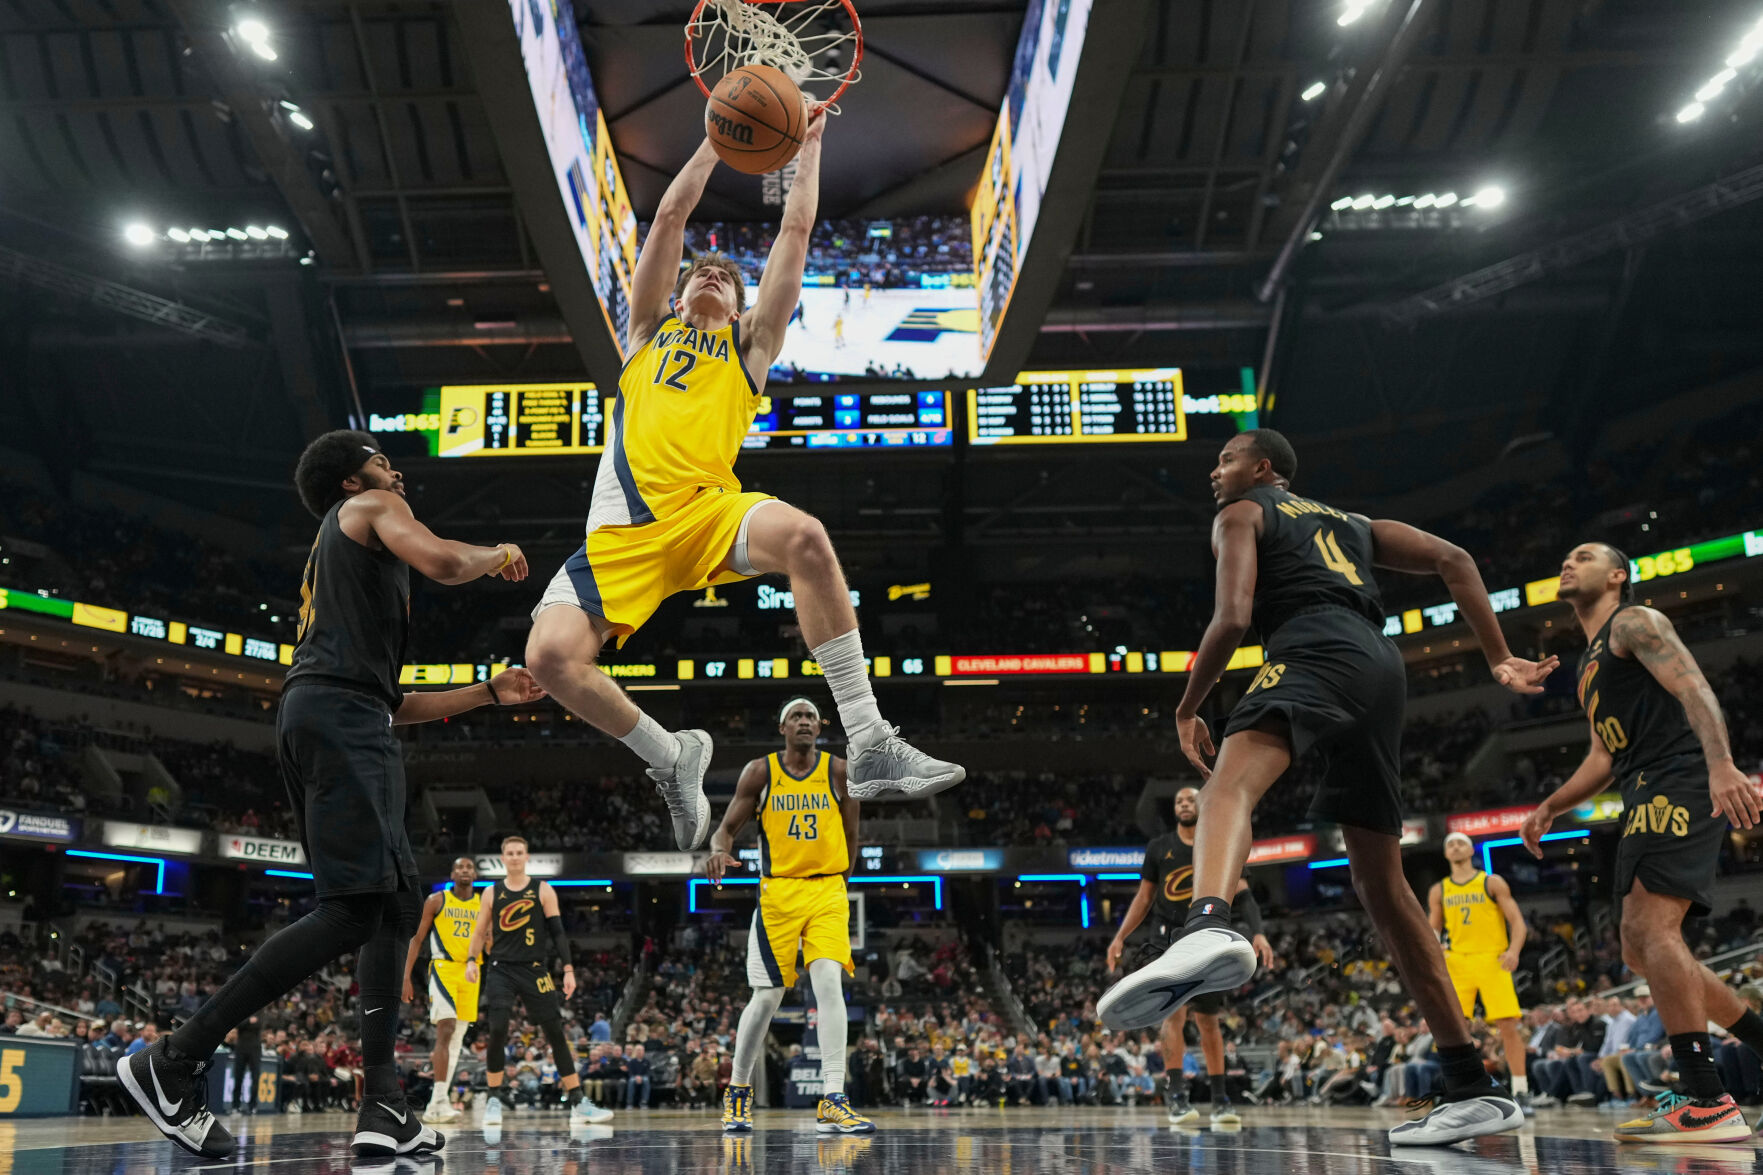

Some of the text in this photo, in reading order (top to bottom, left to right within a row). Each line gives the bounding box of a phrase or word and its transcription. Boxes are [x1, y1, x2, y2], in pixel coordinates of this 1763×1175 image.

[653, 349, 697, 392] 12
[369, 413, 440, 432] bet365
[1314, 528, 1363, 586] 4
[612, 664, 656, 677] PACERS
[706, 662, 726, 677] 67
[902, 658, 923, 674] 65
[957, 657, 1084, 672] CLEVELAND CAVALIERS
[1596, 716, 1629, 753] 20
[771, 793, 831, 812] INDIANA
[787, 814, 819, 841] 43
[1623, 799, 1690, 838] CAVS
[244, 841, 297, 860] DEEM
[1071, 850, 1146, 866] ticketmaste
[1460, 907, 1472, 925] 2
[453, 921, 471, 938] 23
[525, 928, 535, 946] 5
